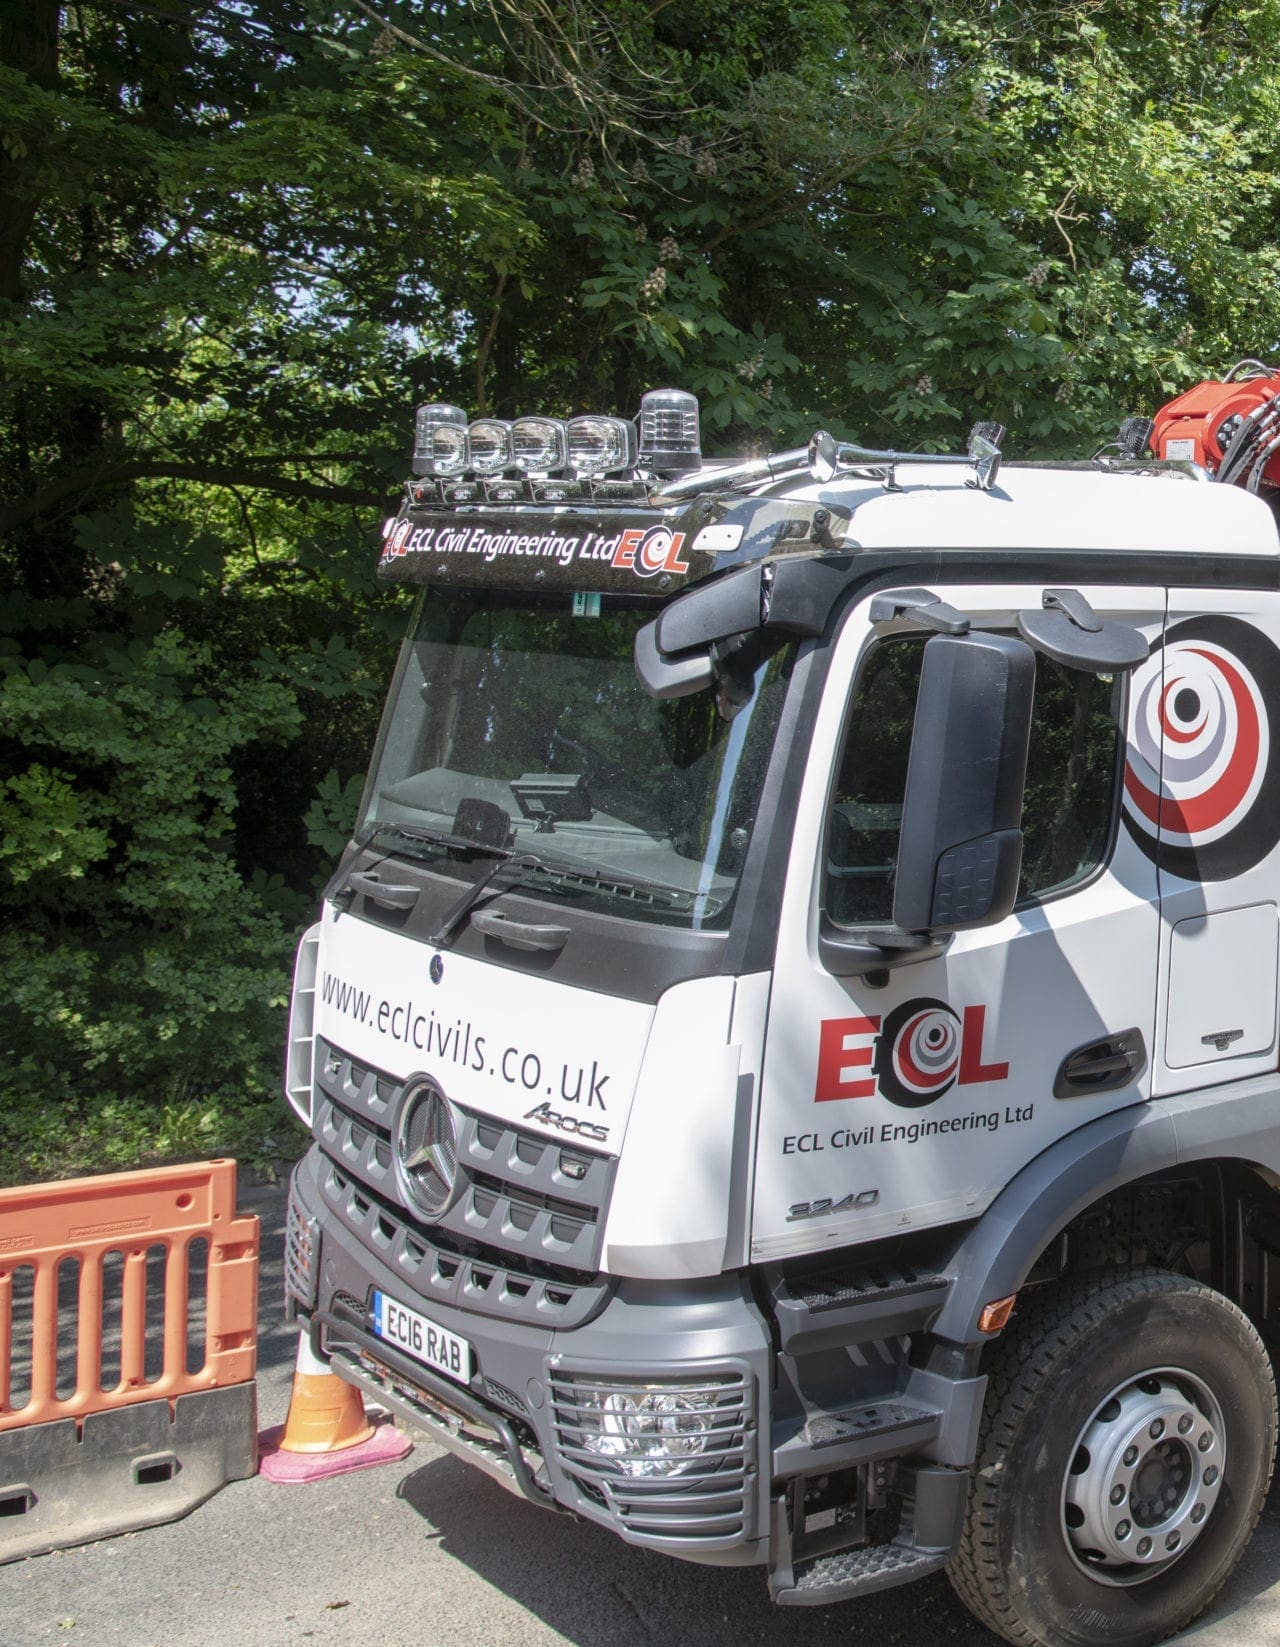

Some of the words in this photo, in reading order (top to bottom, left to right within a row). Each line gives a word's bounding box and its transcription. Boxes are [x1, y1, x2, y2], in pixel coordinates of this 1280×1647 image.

[408, 528, 435, 551] ECL
[435, 527, 470, 552] Civil
[467, 528, 580, 566] Engineering
[579, 532, 621, 560] Ltd
[322, 972, 612, 1111] www.eclcivils.co.uk
[782, 1134, 825, 1155] ECL
[831, 1127, 874, 1149] Civil
[880, 1112, 999, 1143] Engineering
[1005, 1104, 1034, 1123] Ltd
[388, 1304, 422, 1351] EC16
[428, 1327, 460, 1373] RAB
